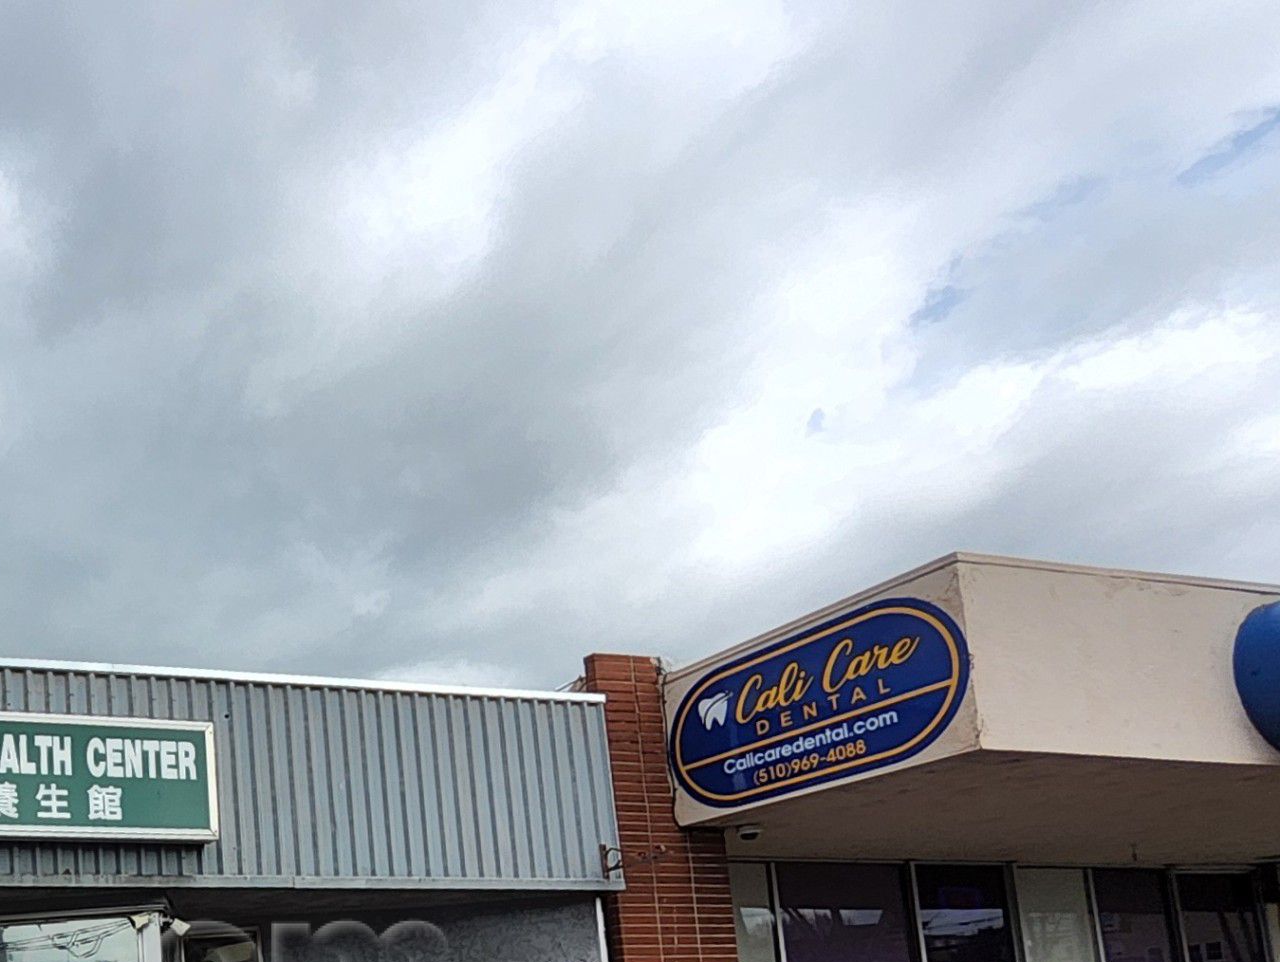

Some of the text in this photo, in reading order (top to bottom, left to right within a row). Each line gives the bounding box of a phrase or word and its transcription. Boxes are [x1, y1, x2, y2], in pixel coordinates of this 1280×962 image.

[734, 637, 920, 724] Cali Care
[756, 679, 891, 736] DENTAL
[86, 737, 197, 780] CENTER
[723, 710, 899, 774] Calicaredental.com
[753, 739, 867, 786] (510)969-4088
